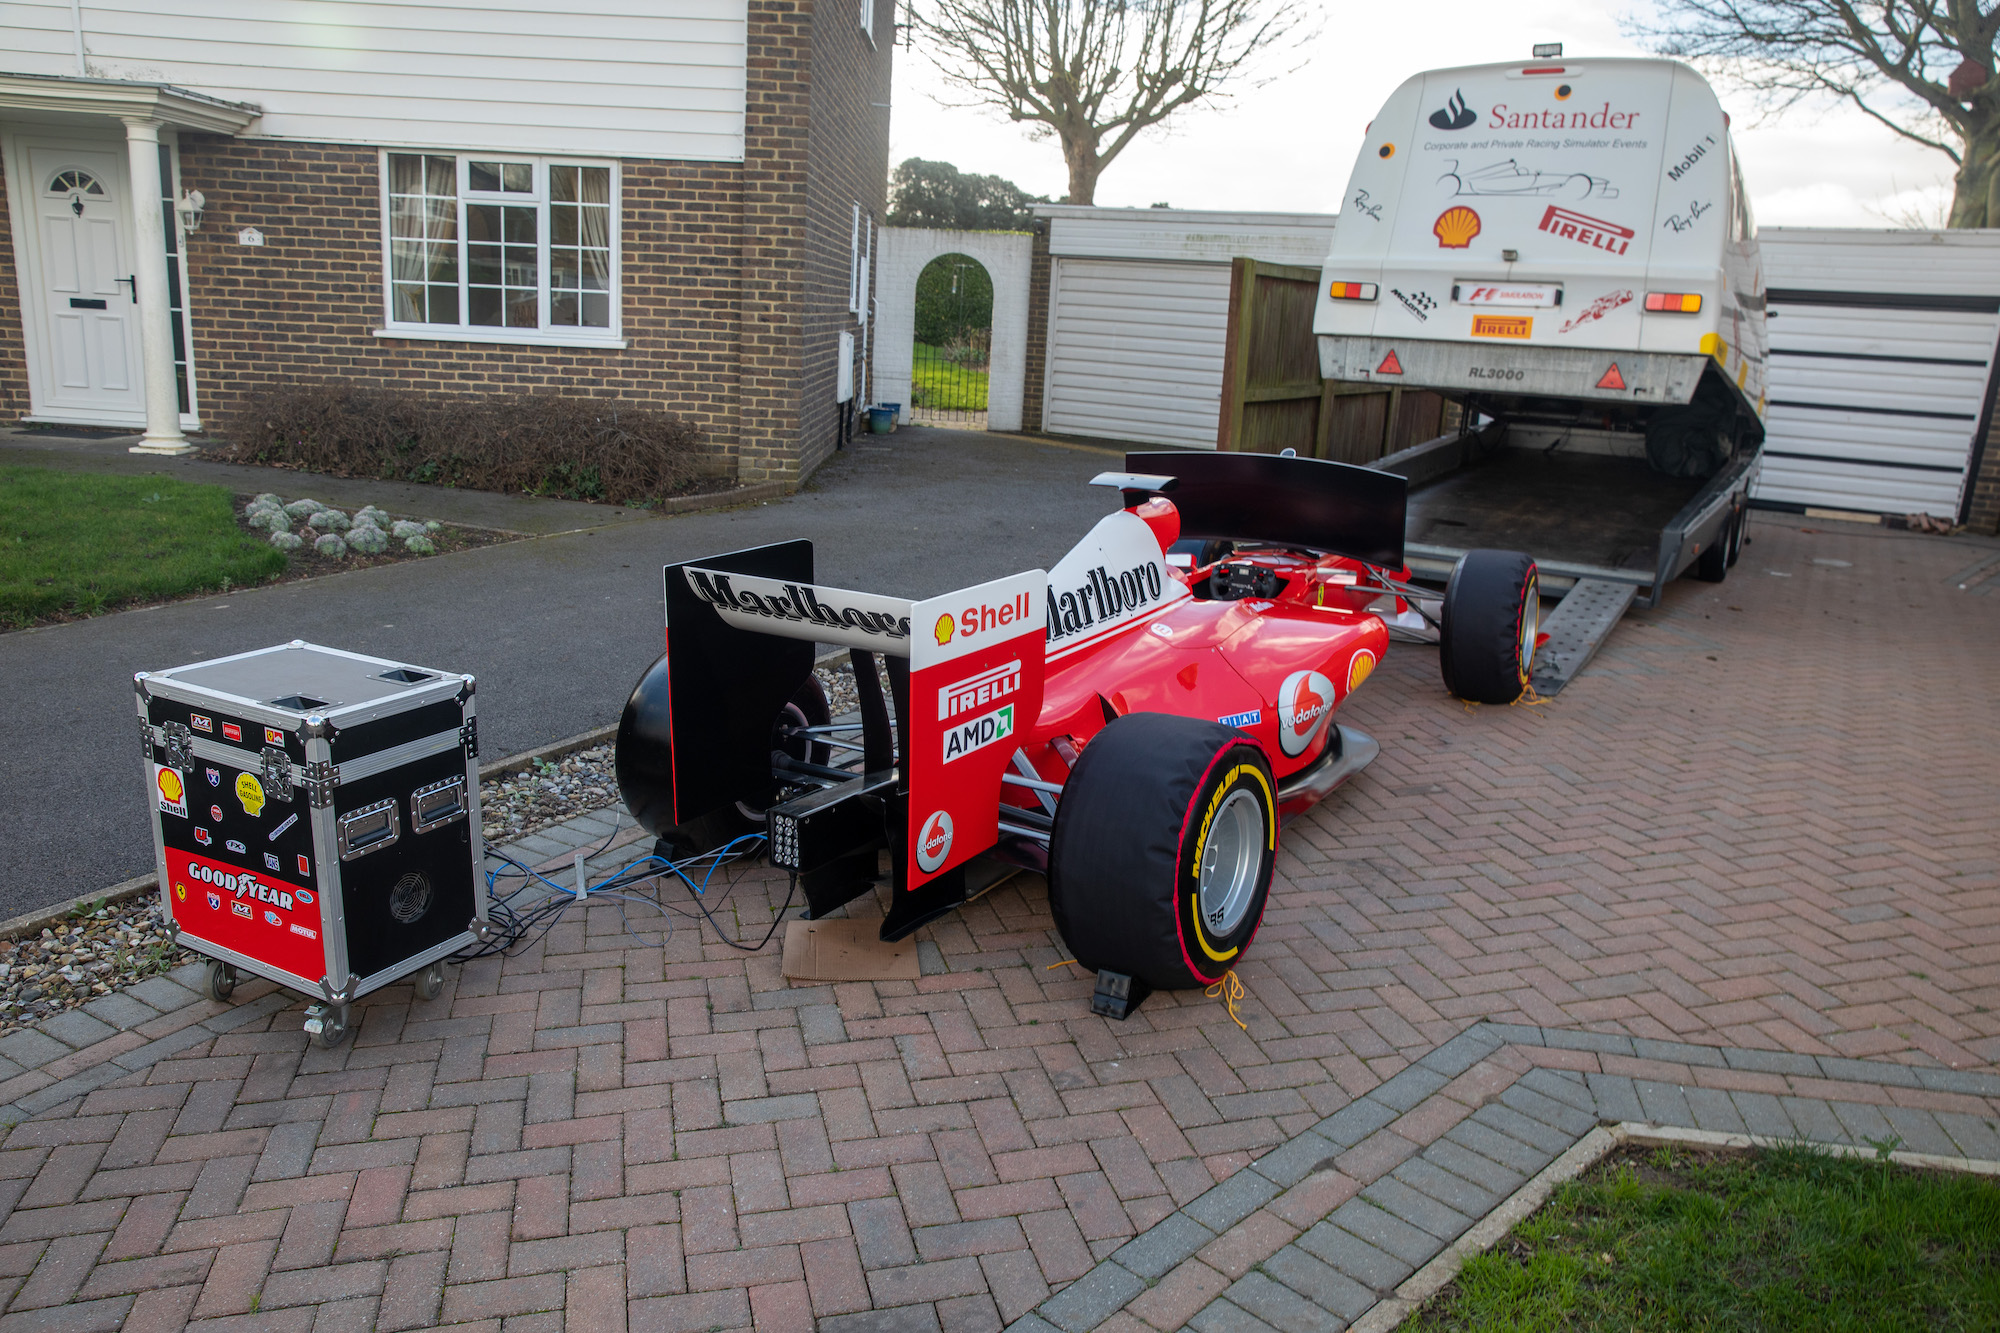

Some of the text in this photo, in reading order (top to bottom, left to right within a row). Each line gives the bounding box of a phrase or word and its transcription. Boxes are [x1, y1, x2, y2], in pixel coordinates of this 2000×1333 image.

[1488, 101, 1640, 130] Santander
[1423, 138, 1648, 153] Corporate and Private Racing Simulator Events
[1667, 135, 1716, 182] Mobil 1
[1537, 204, 1635, 256] PIRELLI
[1475, 318, 1527, 336] PIRELLI
[1468, 367, 1525, 381] RL3000
[960, 591, 1030, 638] Shell
[938, 658, 1022, 722] PIRELLI
[1280, 701, 1333, 730] vodafone
[945, 717, 996, 760] AMD
[239, 789, 262, 804] GASOLINE
[241, 780, 258, 793] SHELL
[160, 800, 187, 817] Shell
[1191, 764, 1240, 880] MICHELIN
[917, 831, 953, 855] vodafone
[291, 924, 316, 939] MOTUL
